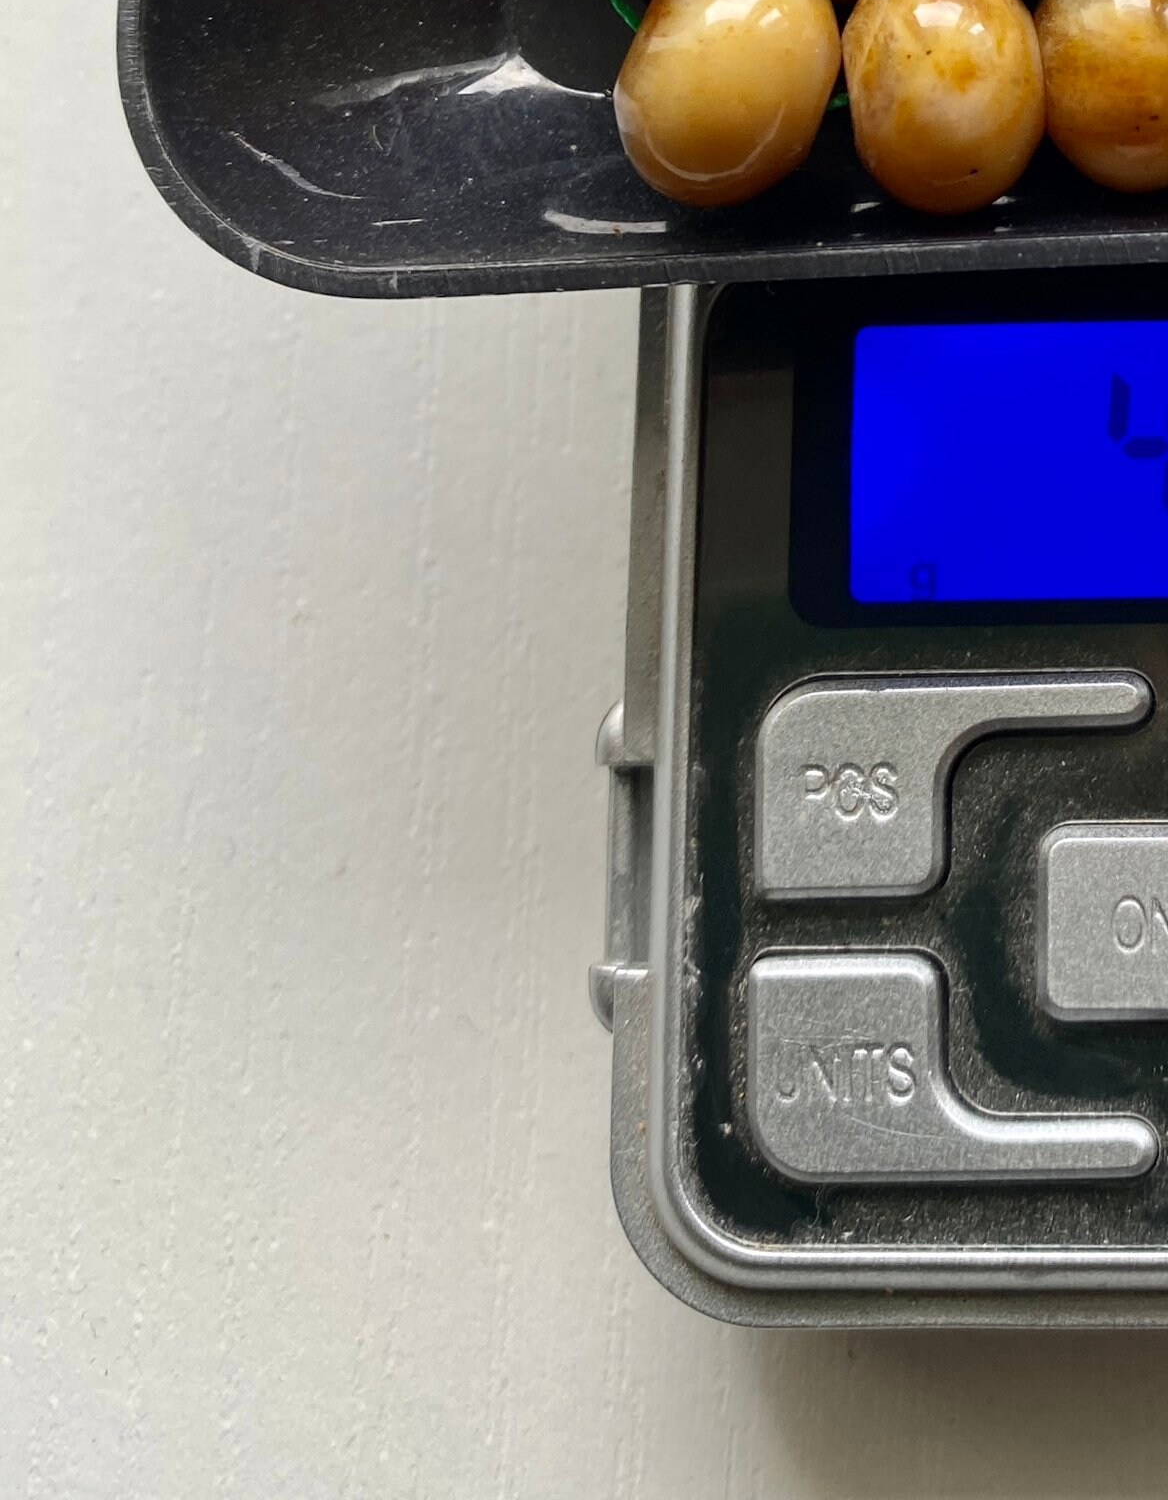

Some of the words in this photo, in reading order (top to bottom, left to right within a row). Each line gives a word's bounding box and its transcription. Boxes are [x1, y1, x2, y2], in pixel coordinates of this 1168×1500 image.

[908, 562, 938, 601] g
[800, 761, 899, 822] PCS
[773, 1041, 916, 1105] UNITS
